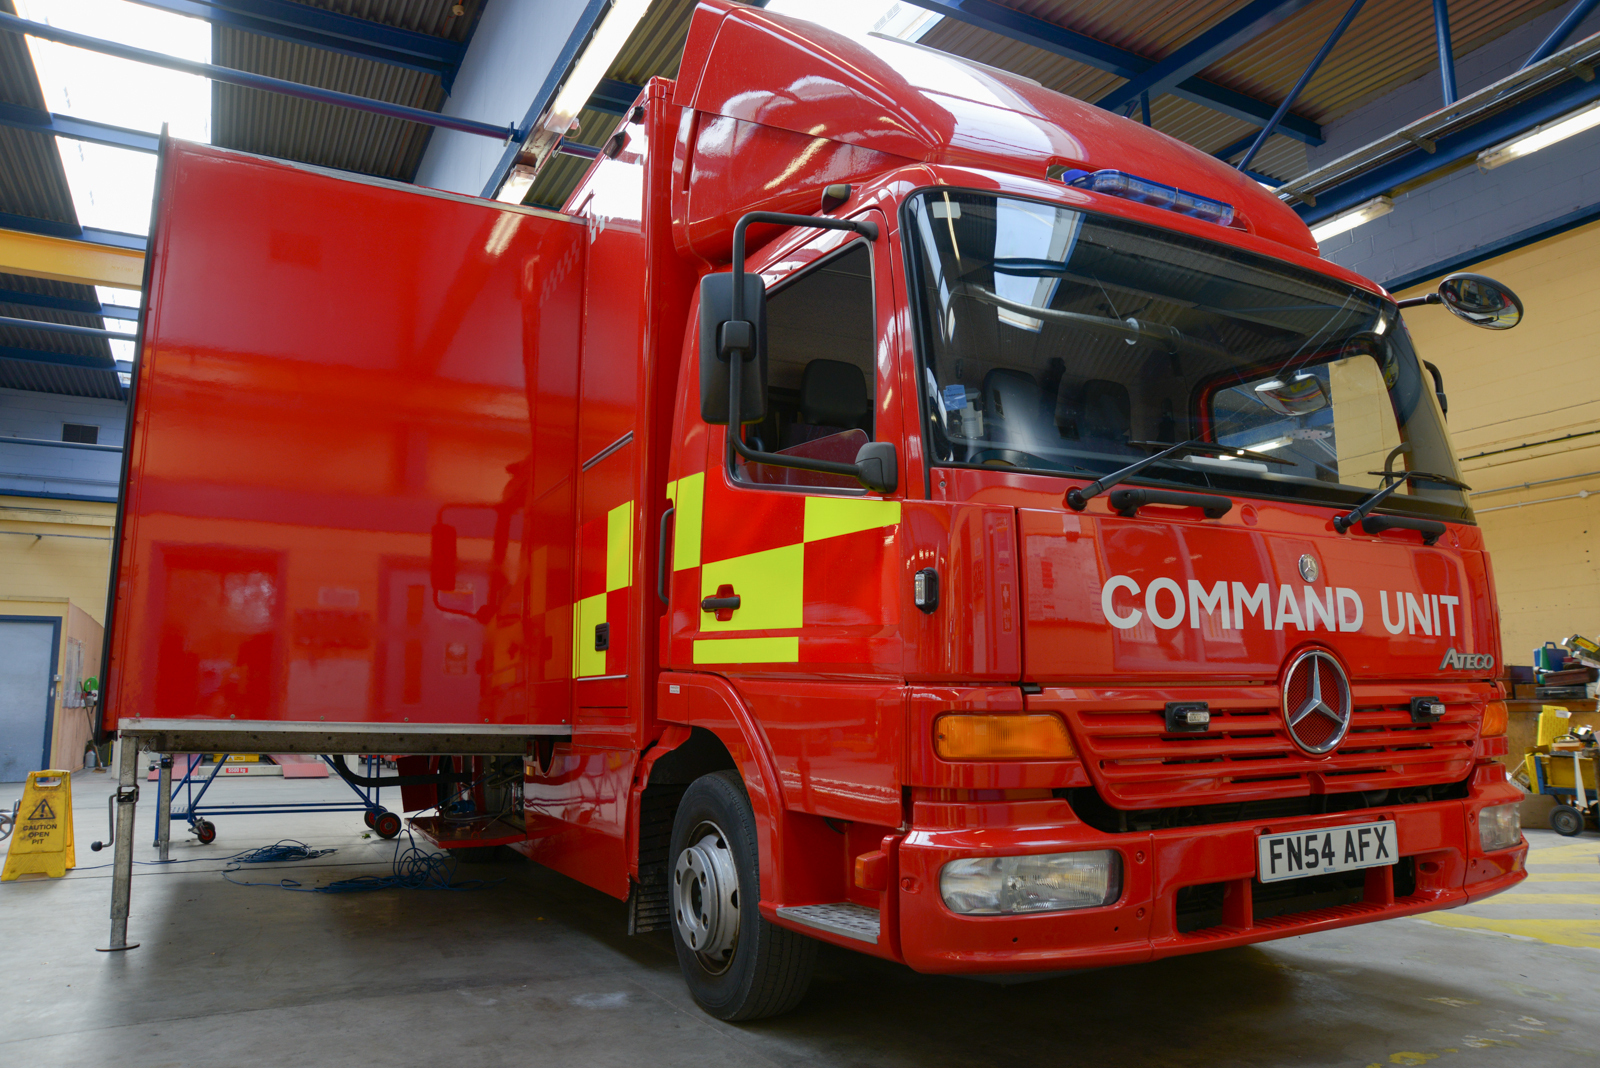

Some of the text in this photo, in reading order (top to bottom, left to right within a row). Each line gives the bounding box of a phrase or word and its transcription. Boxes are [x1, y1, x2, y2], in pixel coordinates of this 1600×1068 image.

[1101, 574, 1459, 637] COMMAND UNIT
[1269, 826, 1389, 874] FN54 AFX
